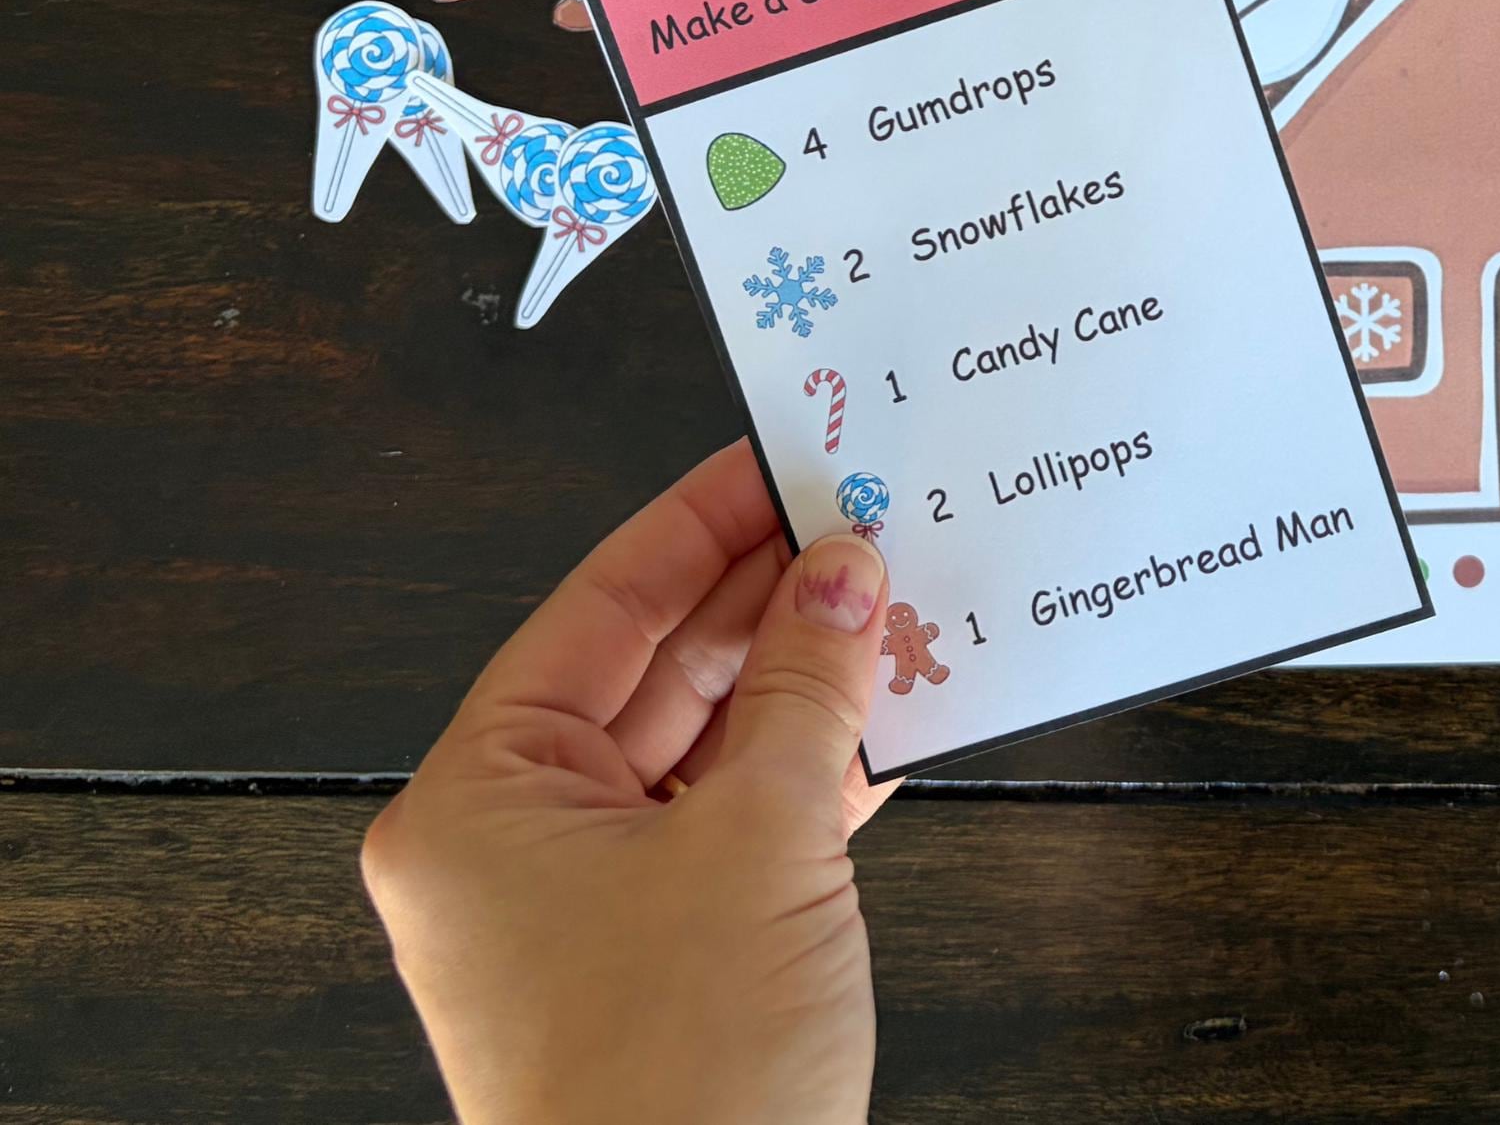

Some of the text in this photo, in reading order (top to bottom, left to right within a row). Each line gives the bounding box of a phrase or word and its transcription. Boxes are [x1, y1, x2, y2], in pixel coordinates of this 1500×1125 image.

[651, 1, 754, 54] Make
[803, 59, 1055, 159] 4 Gumdrops
[843, 171, 1124, 283] 2 Snowflakes
[886, 297, 1163, 403] 1 Candy Cane
[927, 431, 1152, 522] 2 Lollipops
[966, 508, 1354, 645] 1 Gingerbread Man
